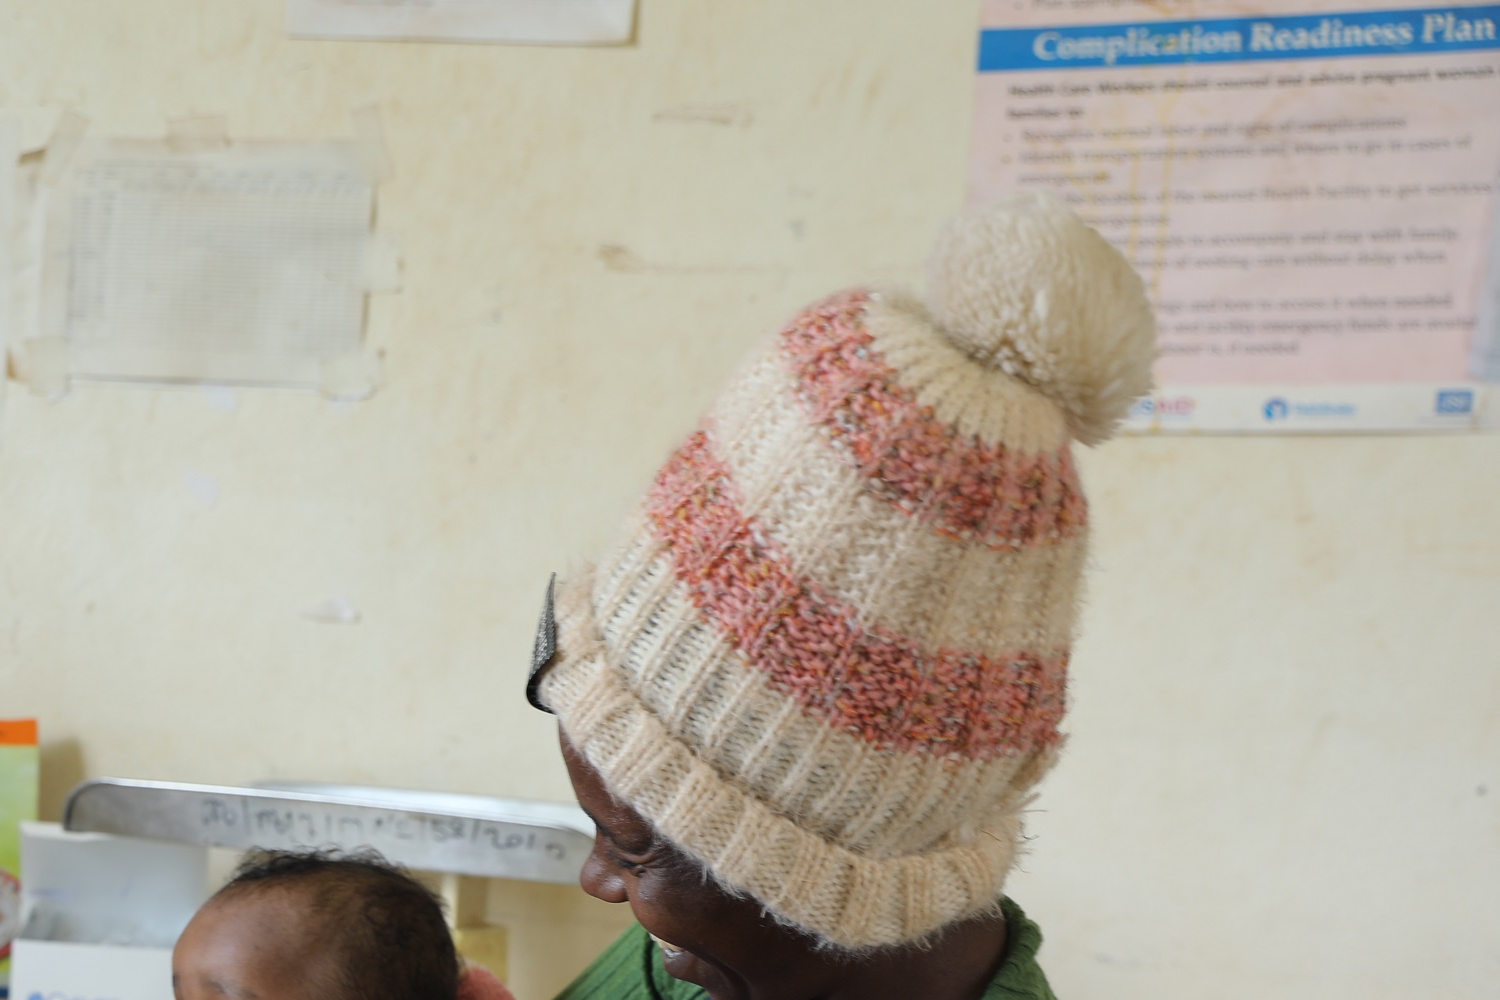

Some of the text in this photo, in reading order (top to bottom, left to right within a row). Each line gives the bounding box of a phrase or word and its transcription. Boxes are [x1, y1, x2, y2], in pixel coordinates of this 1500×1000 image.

[1033, 12, 1496, 65] Complication Readiness Plan
